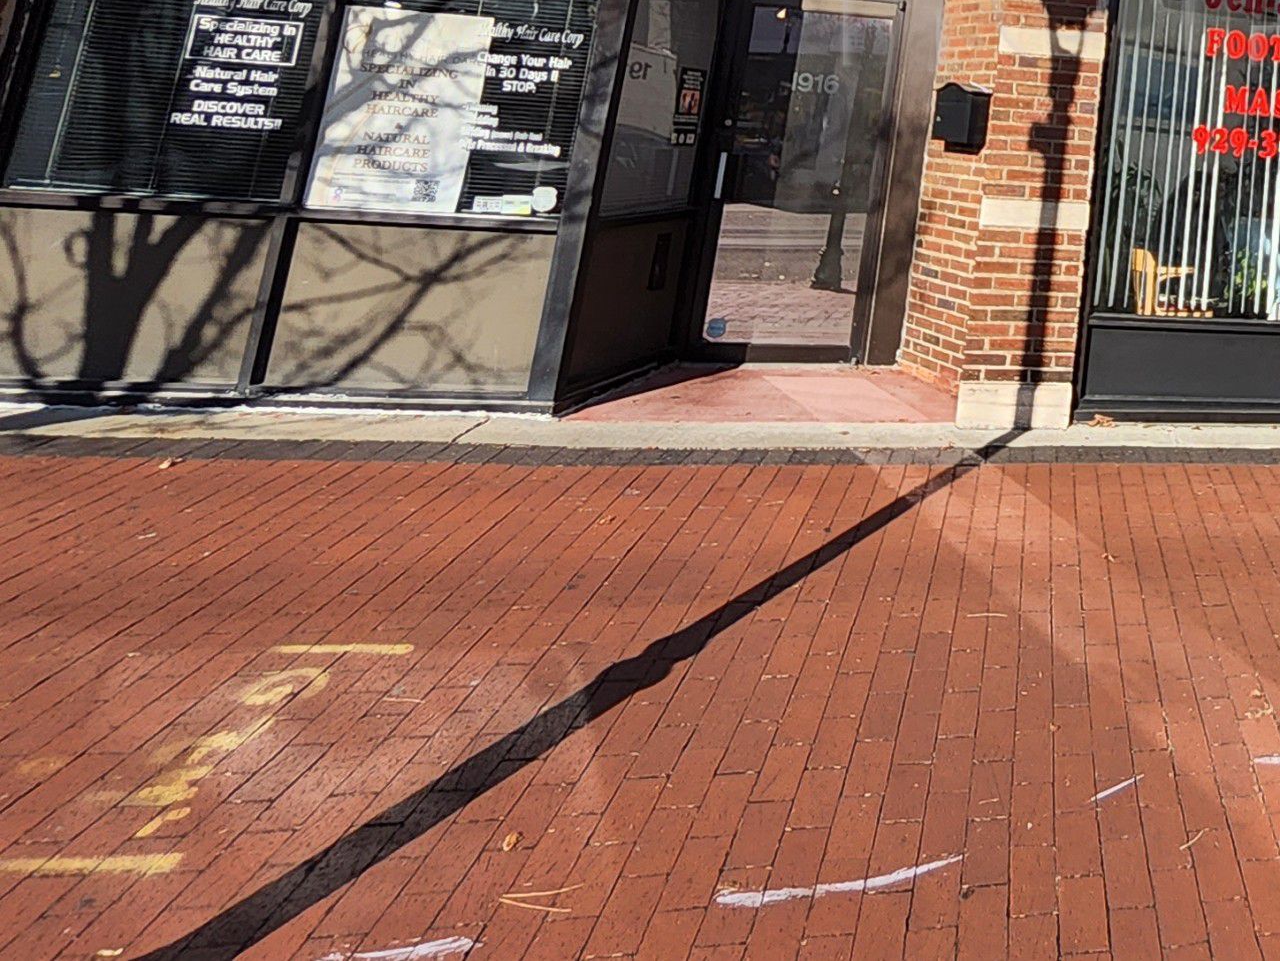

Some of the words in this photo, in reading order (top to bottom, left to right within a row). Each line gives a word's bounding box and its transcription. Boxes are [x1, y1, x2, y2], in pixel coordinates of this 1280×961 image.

[199, 18, 280, 36] Specializing
[203, 46, 238, 59] HAIR
[241, 48, 282, 62] CARE
[477, 51, 518, 66] Change
[520, 54, 547, 67] Your
[548, 56, 572, 69] Hair
[194, 66, 247, 81] Natural
[249, 69, 279, 82] Hair
[361, 63, 458, 79] SPECIALIZING
[519, 68, 548, 83] Days
[189, 79, 223, 92] Care
[225, 82, 278, 97] System
[400, 79, 417, 89] IN
[791, 72, 839, 96] 1916
[372, 90, 440, 104] HEALTHY
[192, 99, 265, 115] DISCOVER
[366, 104, 439, 118] HAIRCARE
[170, 112, 208, 125] REAL
[363, 131, 430, 145] NATURAL
[357, 144, 430, 158] HAIRCARE
[353, 158, 429, 173] PRODUCTS
